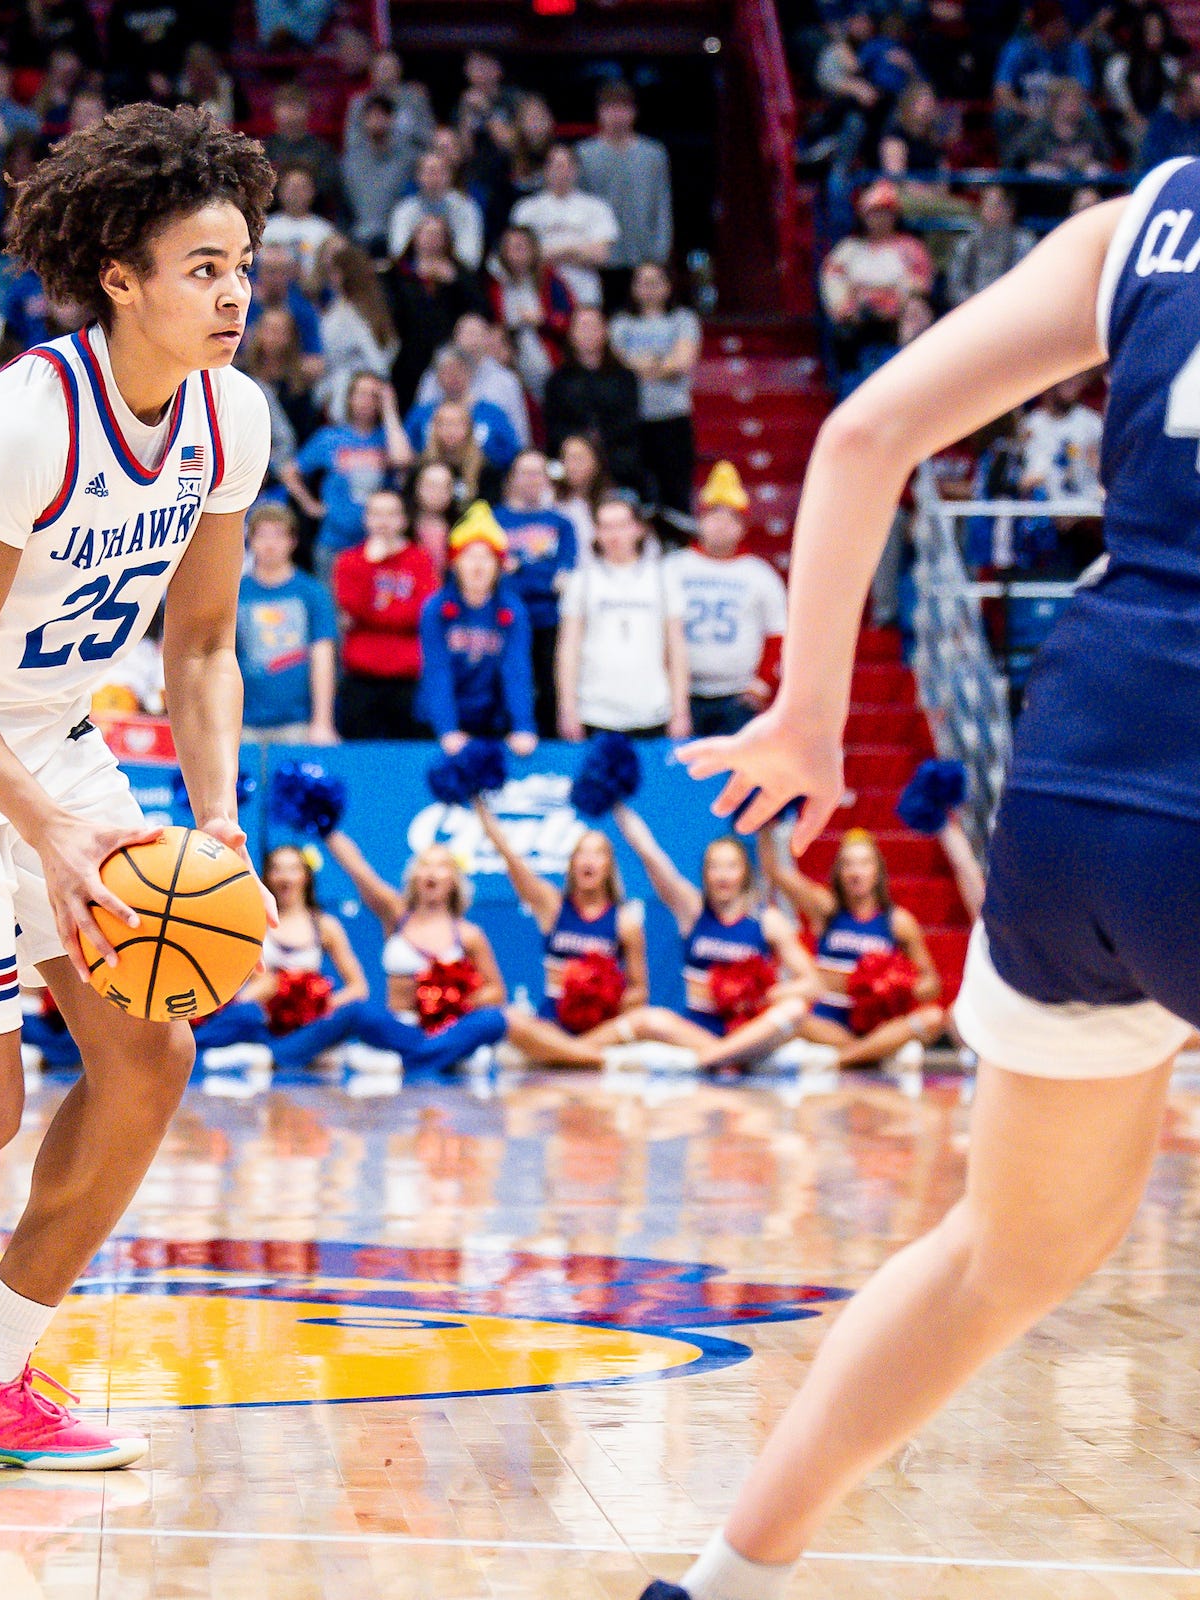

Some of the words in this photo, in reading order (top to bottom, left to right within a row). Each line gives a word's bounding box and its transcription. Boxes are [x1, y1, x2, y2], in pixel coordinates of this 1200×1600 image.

[50, 503, 200, 570] JAYHAWK
[17, 560, 171, 669] 25
[683, 599, 740, 645] 25
